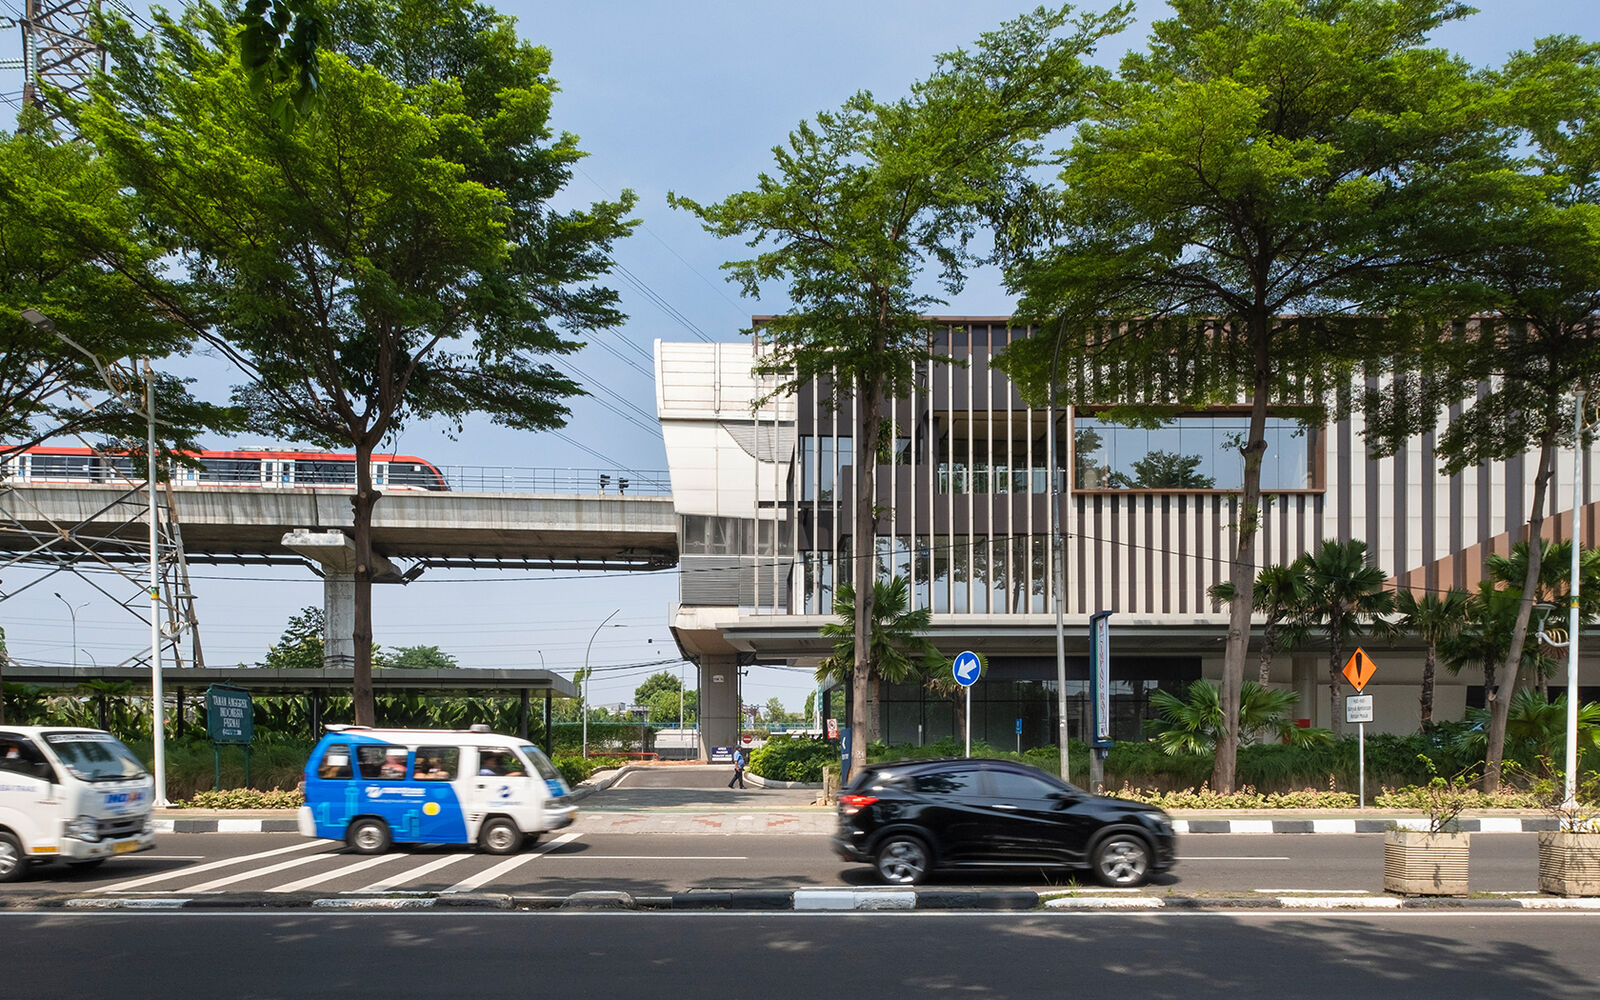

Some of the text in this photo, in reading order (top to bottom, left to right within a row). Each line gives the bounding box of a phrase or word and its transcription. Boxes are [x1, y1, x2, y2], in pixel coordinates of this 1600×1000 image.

[212, 695, 248, 709] TAMAN ANGGREK
[220, 707, 244, 718] INDONESIA
